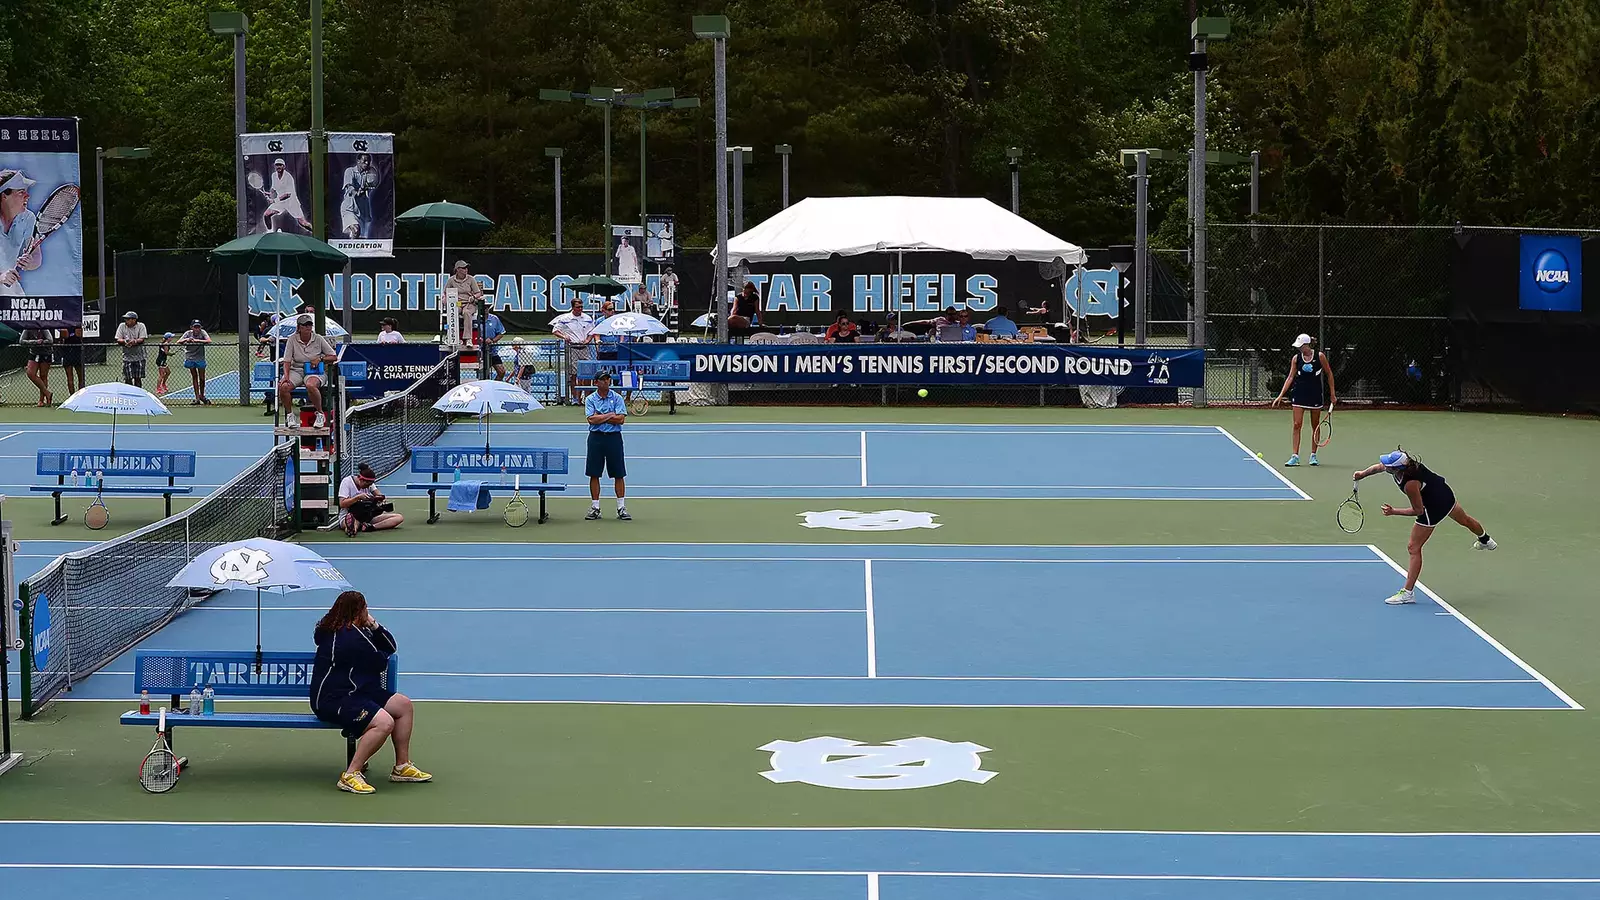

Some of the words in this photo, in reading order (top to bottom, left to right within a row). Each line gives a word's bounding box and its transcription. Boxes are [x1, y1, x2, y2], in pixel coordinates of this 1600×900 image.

[18, 130, 70, 140] HEELS
[1536, 270, 1569, 282] NCAA
[325, 273, 452, 310] NORTH
[852, 274, 998, 312] HEELS
[11, 299, 46, 310] NCAA
[696, 355, 778, 373] DIVISION
[795, 356, 853, 374] MEN'S
[858, 356, 924, 374] TENNIS
[930, 354, 1060, 375] FIRST/SECOND
[1064, 357, 1132, 376] ROUND
[113, 398, 138, 406] HEELS
[70, 456, 162, 470] TARHEELS
[446, 453, 534, 468] CAROLINA
[15, 640, 24, 648] 2
[34, 628, 50, 656] NCAA
[190, 662, 315, 685] TARHEE
